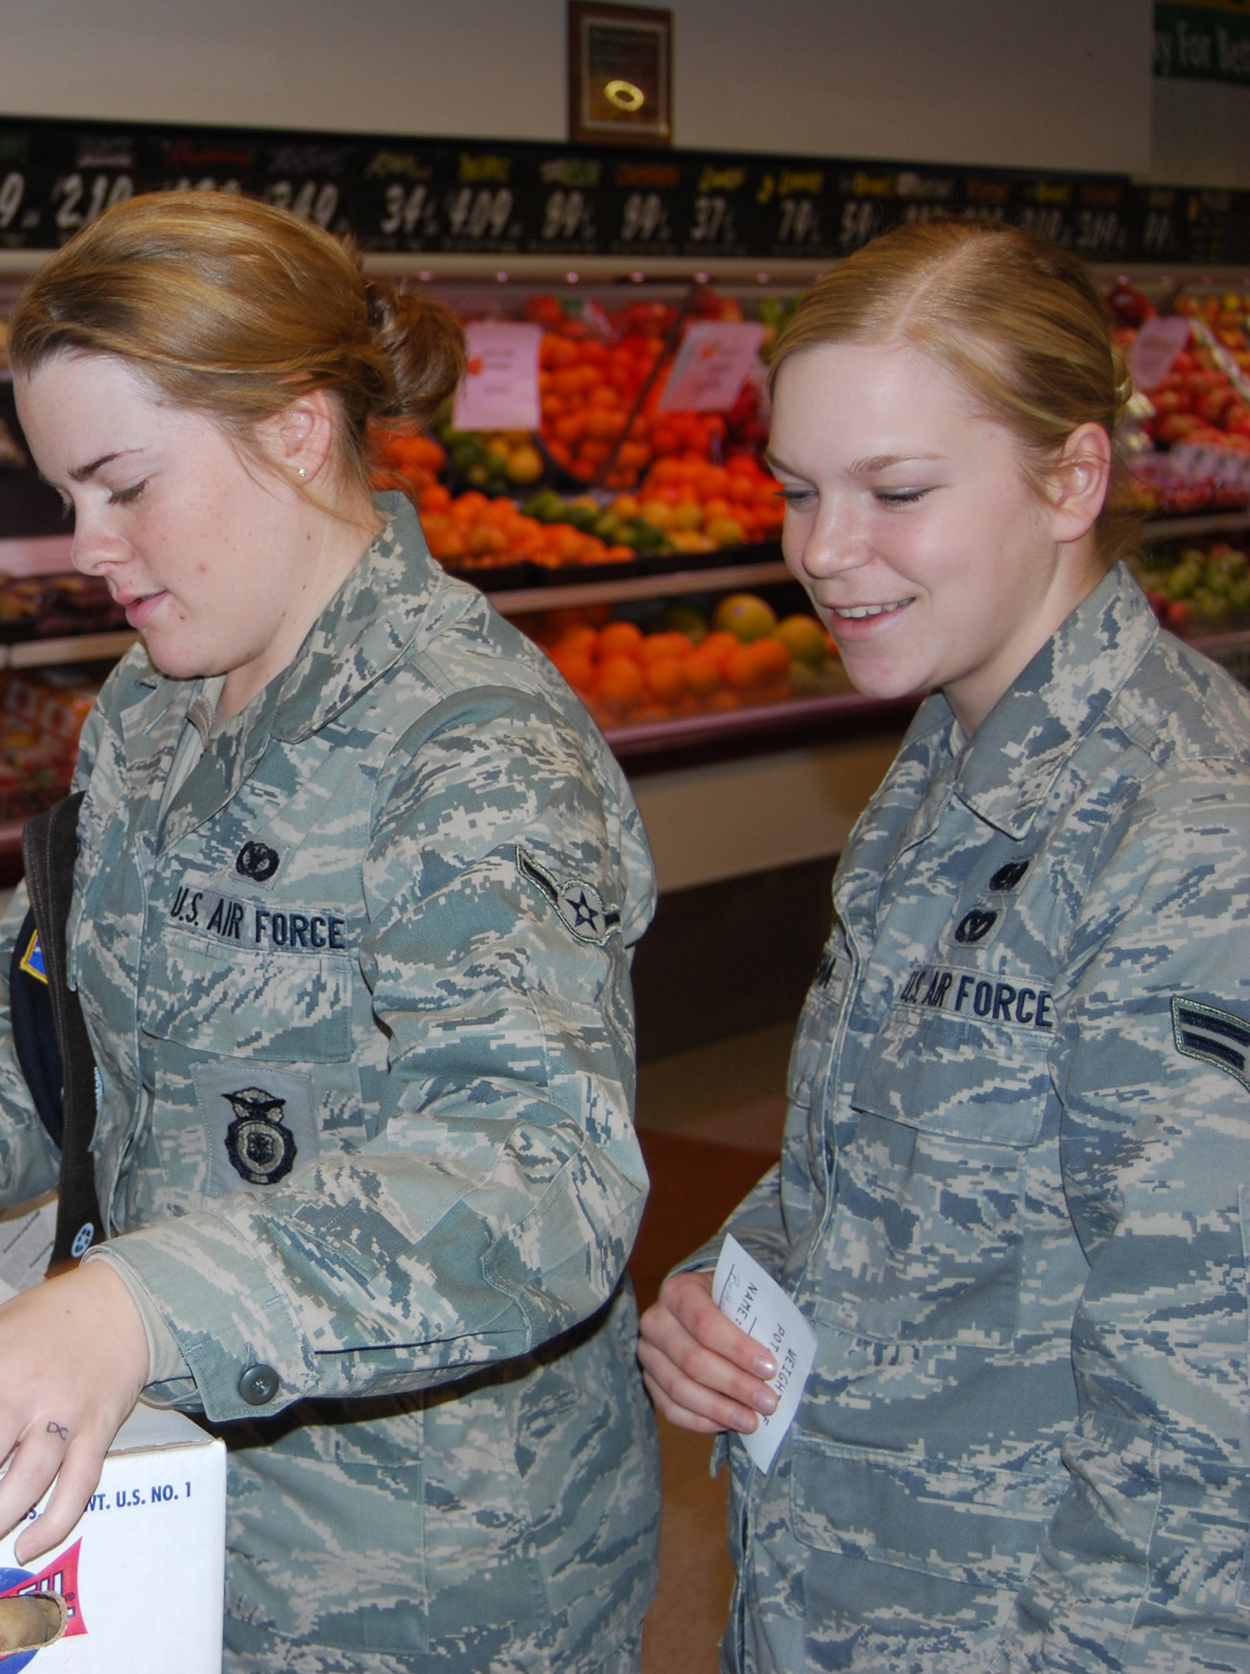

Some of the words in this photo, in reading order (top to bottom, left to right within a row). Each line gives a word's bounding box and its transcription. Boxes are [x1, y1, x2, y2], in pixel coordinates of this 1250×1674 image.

[169, 886, 203, 927] U.S.
[206, 897, 245, 940] AIR
[254, 909, 347, 950] FORCE
[921, 970, 953, 1008] AIR
[954, 975, 1054, 1028] FORCE
[734, 1281, 759, 1326] NAME:
[116, 1488, 146, 1508] U.S.
[151, 1484, 180, 1504] NO.
[185, 1481, 192, 1498] 1
